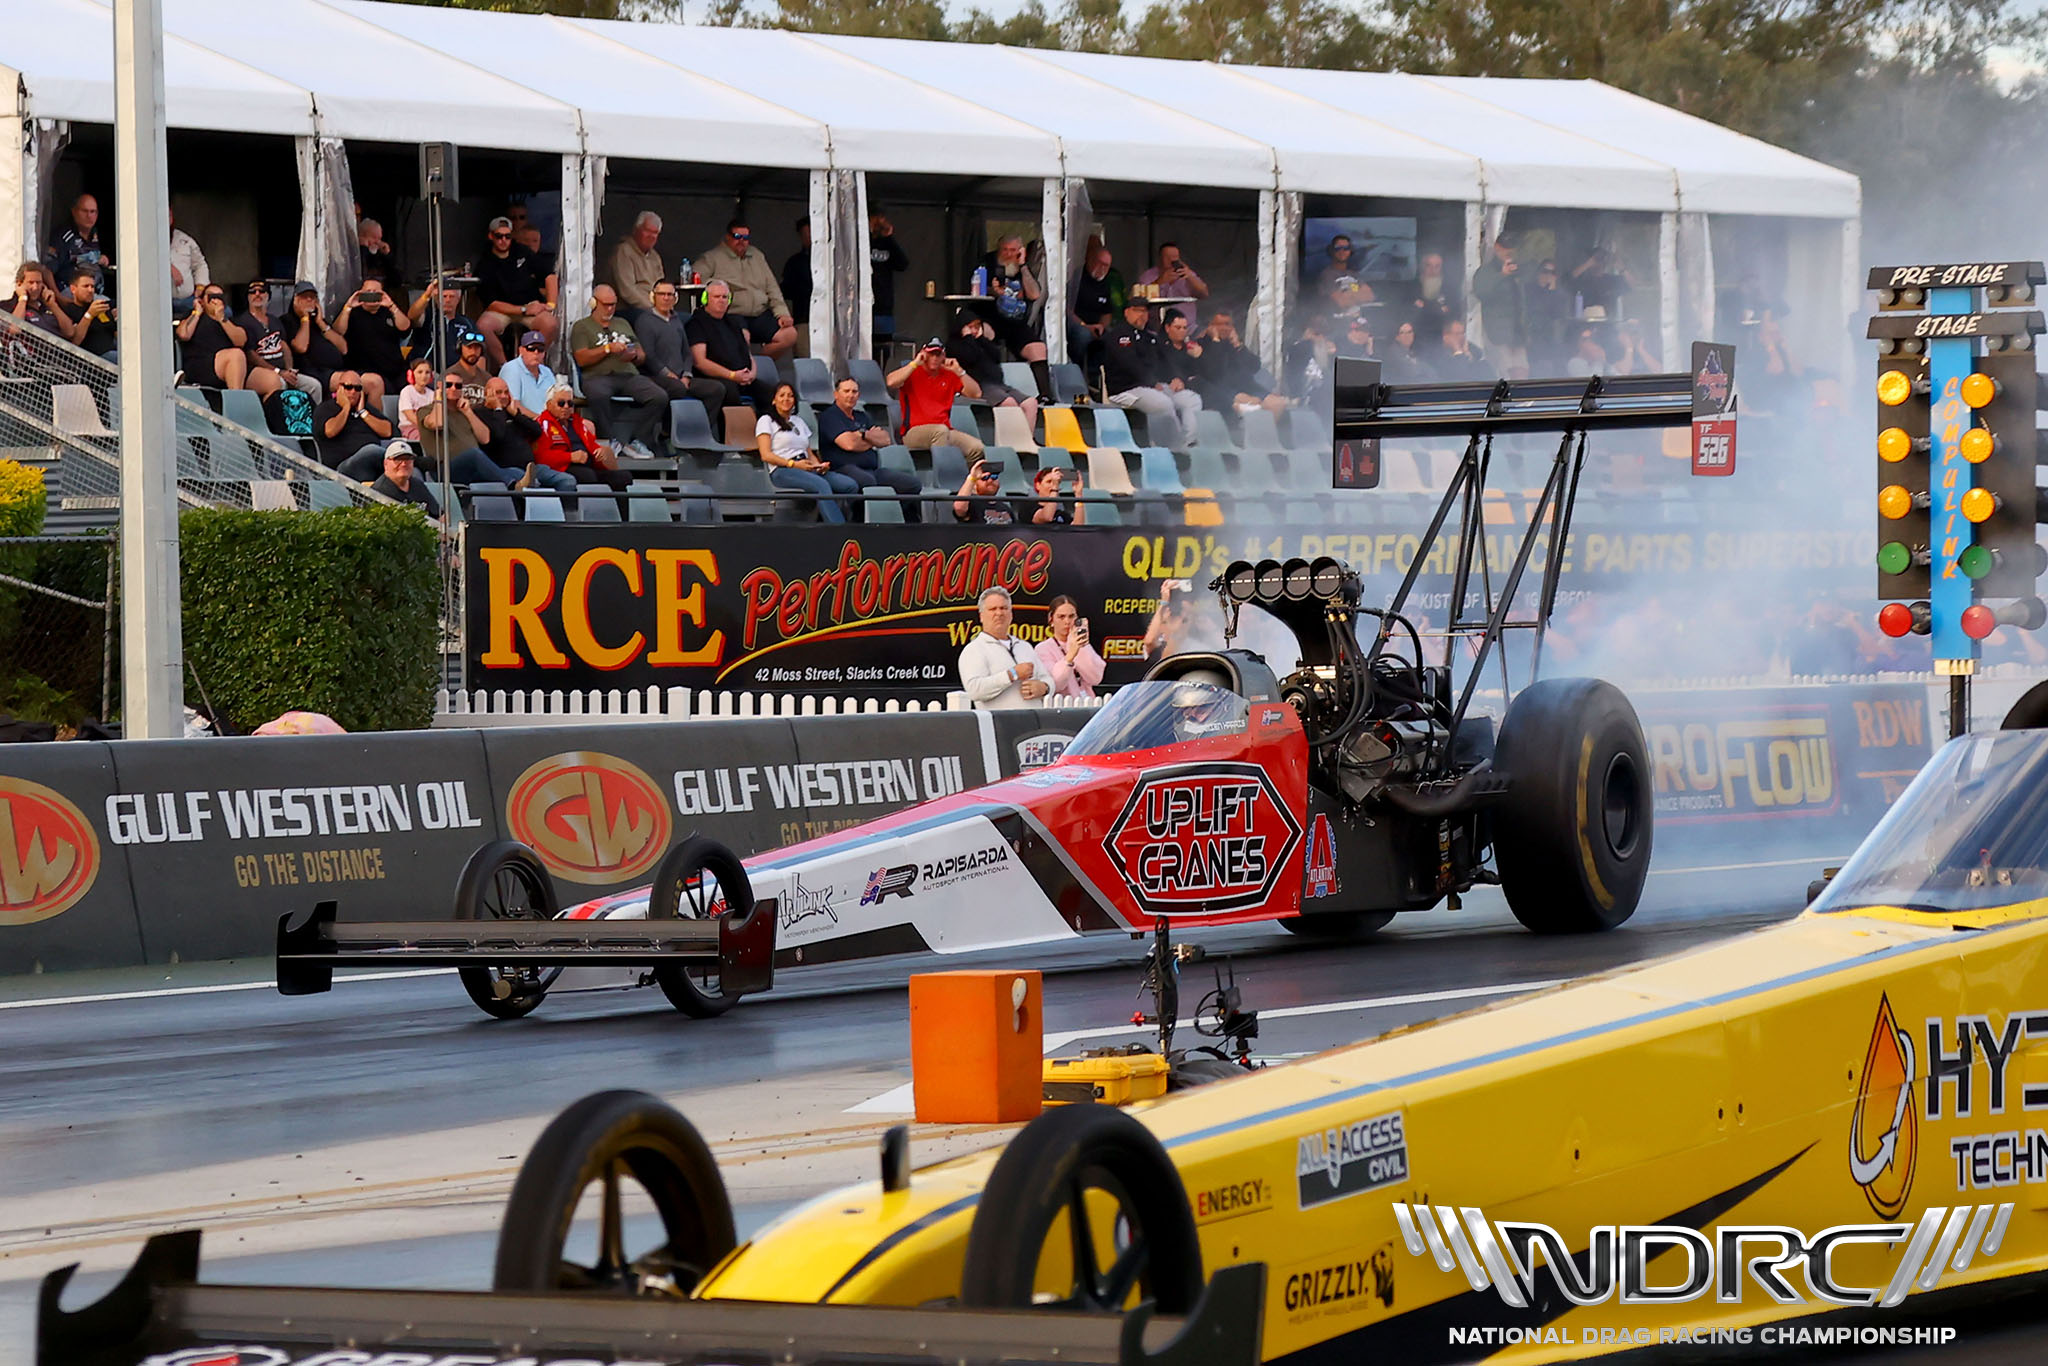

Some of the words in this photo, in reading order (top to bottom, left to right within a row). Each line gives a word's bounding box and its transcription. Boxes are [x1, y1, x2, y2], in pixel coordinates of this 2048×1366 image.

[1889, 264, 2008, 286] PRE-STAGE
[1914, 315, 1982, 337] STAGE
[1701, 423, 1713, 434] TF
[1942, 376, 1960, 580] COMPULINK
[1122, 536, 1230, 581] QLD's
[1301, 534, 1576, 578] PERFORMANCE
[1584, 533, 1693, 574] PARTS
[1703, 530, 1878, 570] SUPERSTO
[480, 547, 727, 670] RCE
[740, 539, 1052, 650] Performance
[755, 667, 769, 682] 42
[772, 668, 802, 682] Moss
[804, 666, 843, 682] Street,
[846, 666, 883, 680] Slacks
[886, 665, 919, 680] Creek
[922, 665, 946, 679] QLD
[1853, 699, 1923, 748] RDW
[1024, 741, 1073, 764] IHR
[1651, 718, 1833, 809] ROFLOW
[674, 767, 760, 816] GULF
[764, 758, 918, 809] WESTERN
[105, 791, 212, 845] GULF
[217, 783, 413, 839] WESTERN
[417, 780, 482, 830] OIL
[1146, 784, 1262, 839] UPLIFT
[781, 822, 801, 846] GO
[234, 855, 261, 888] GO
[263, 852, 299, 886] THE
[303, 848, 386, 884] DISTANCE
[923, 845, 1009, 881] RAPISARDA
[923, 877, 959, 891] AUTOSPORT
[961, 864, 1010, 881] INTERNATIONAL
[1138, 835, 1267, 893] CRANES
[1309, 867, 1334, 882] ATLANTIC
[1299, 1133, 1329, 1171] ALL
[1341, 1115, 1404, 1158] ACCESS
[1368, 1154, 1405, 1182] CIVIL
[1197, 1178, 1263, 1217] ENERGY
